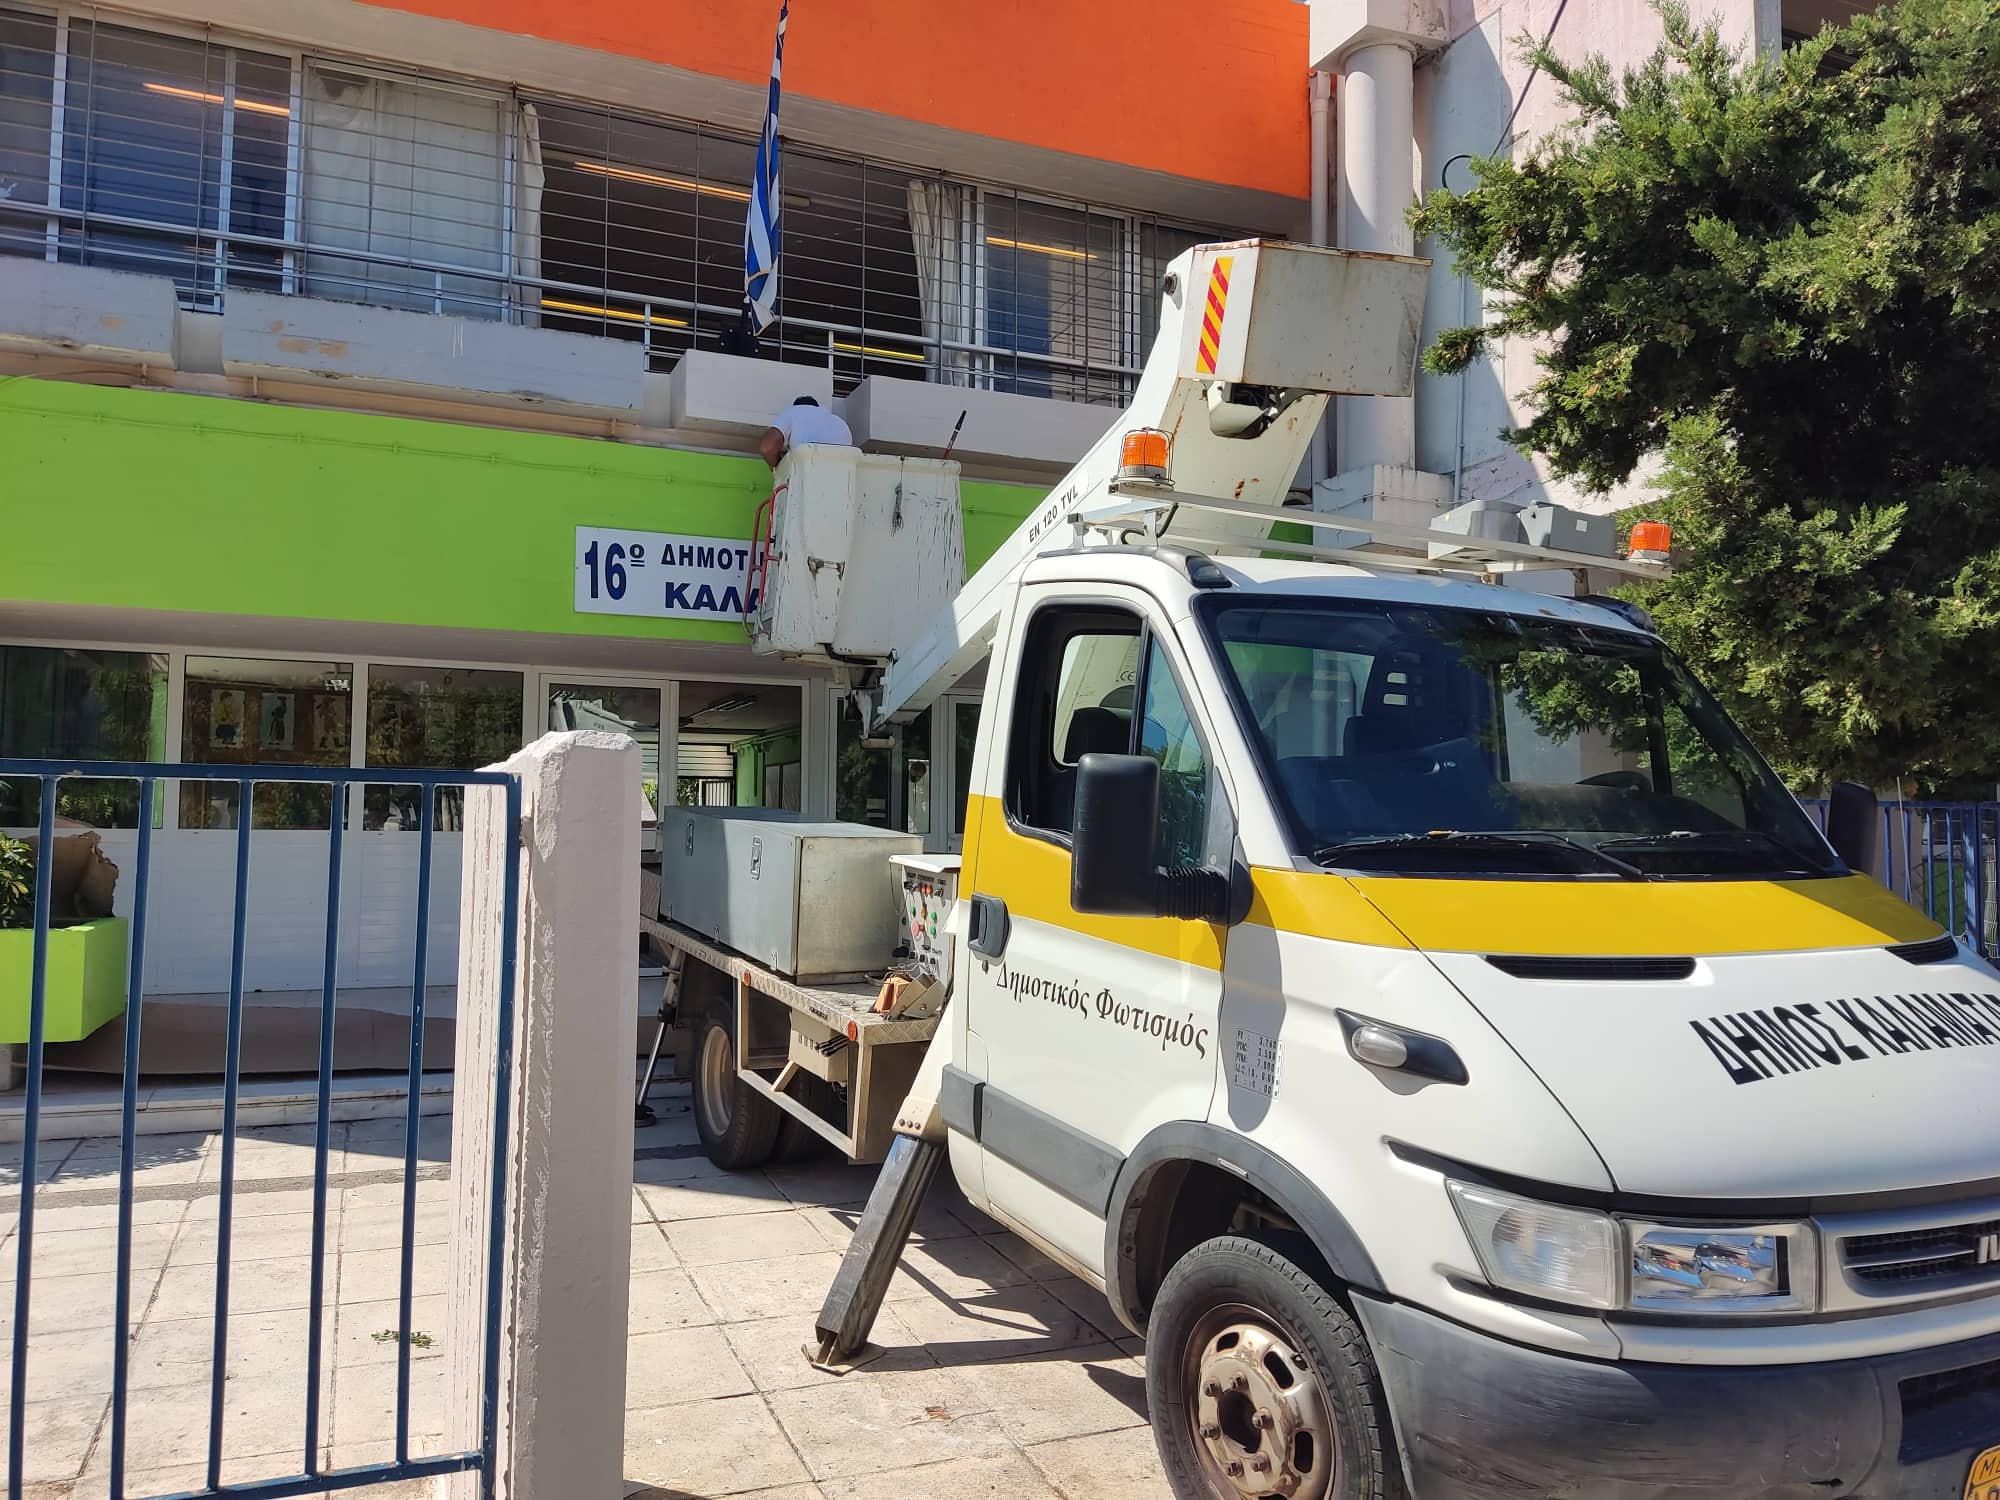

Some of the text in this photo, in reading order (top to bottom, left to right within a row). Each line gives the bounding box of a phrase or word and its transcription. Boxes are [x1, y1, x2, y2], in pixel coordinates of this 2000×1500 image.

[1029, 485, 1078, 543] EN 120 TVL
[996, 961, 1209, 1060] Δημοτικός Φωτισμός
[1688, 1002, 1872, 1085] ΔΗΜΟΣ
